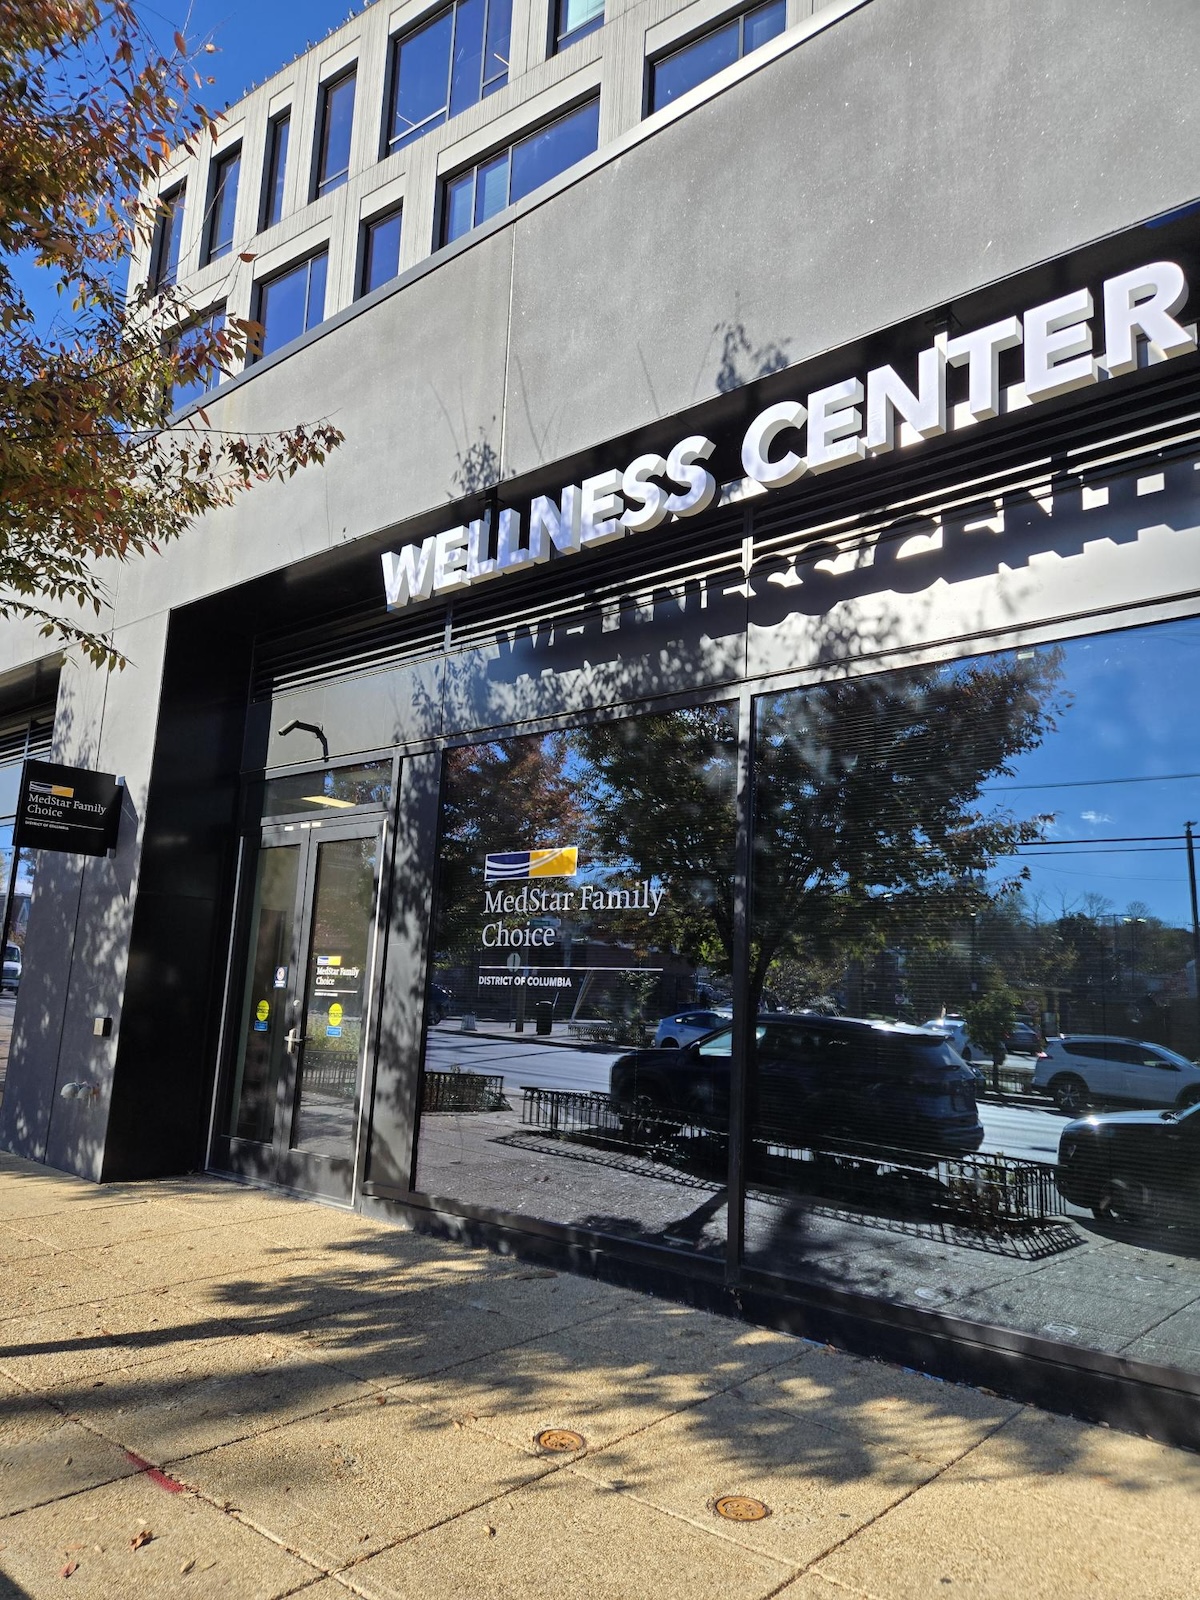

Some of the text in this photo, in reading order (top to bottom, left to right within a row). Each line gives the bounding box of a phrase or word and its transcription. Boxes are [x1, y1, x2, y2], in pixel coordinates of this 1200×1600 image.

[381, 261, 1198, 612] WELLNESS CENTER
[27, 804, 63, 818] Choice
[28, 793, 107, 815] MedStar Family
[483, 880, 666, 917] MedStar Family
[481, 921, 556, 948] Choice
[315, 976, 335, 985] Choice
[316, 966, 359, 978] MedStar Family
[478, 975, 572, 988] DISTRICT OF COLUMBIA
